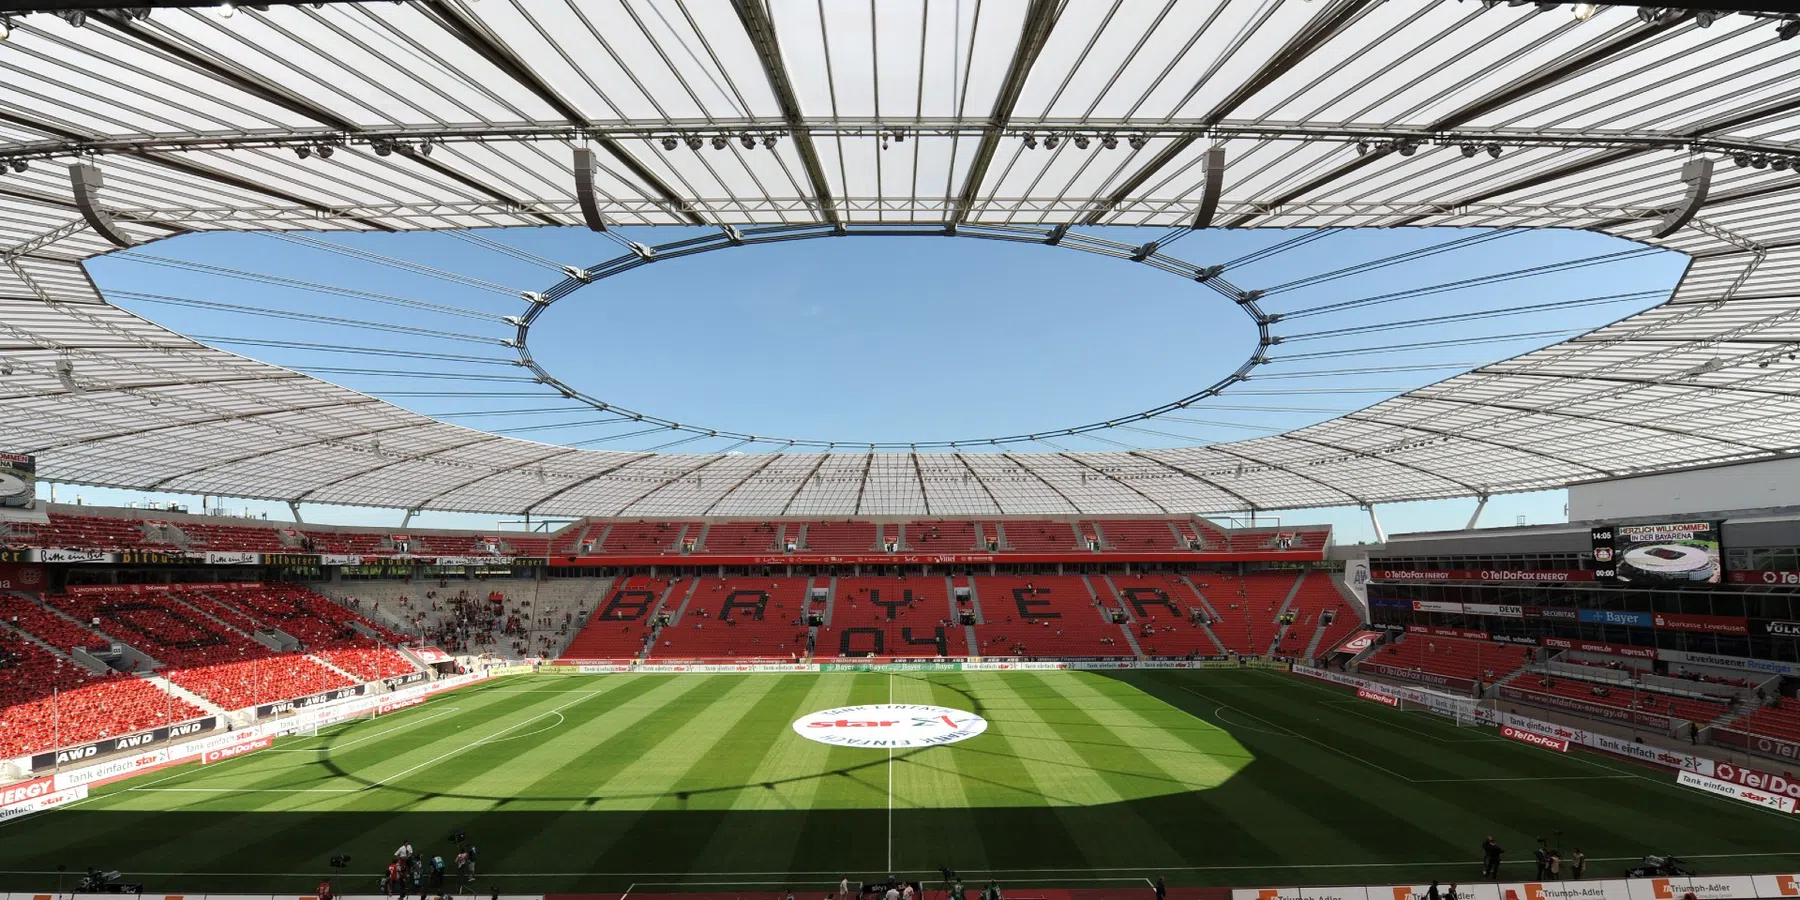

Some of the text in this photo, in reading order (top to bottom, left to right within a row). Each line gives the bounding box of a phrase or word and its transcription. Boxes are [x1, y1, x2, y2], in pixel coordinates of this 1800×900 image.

[1620, 524, 1708, 534] HERZLICH WILLKOMMEN
[1593, 532, 1612, 540] 14:05
[1655, 533, 1692, 541] BAYARENA
[1490, 571, 1568, 580] TelDaFax ENERGY
[1499, 606, 1521, 614] DEVK
[1542, 610, 1575, 619] SECURITAS
[1606, 611, 1639, 624] Bayer
[1667, 620, 1746, 632] Sparkasse Leverkusen
[839, 626, 947, 656] 04
[1581, 643, 1612, 653] express.de
[1620, 647, 1655, 657] express.TV
[1685, 653, 1791, 674] Leverkusener Anzeiger
[407, 674, 422, 683] AWD
[305, 696, 327, 706] AWD
[391, 696, 423, 710] TelDaFax
[1364, 691, 1393, 705] TelDaFax
[270, 702, 294, 715] AWD
[170, 722, 202, 737] AWD
[806, 719, 900, 728] star
[1509, 716, 1525, 727] Tank
[1526, 719, 1553, 733] einfach
[1553, 724, 1573, 738] star
[117, 734, 153, 750] AWD
[236, 731, 252, 741] star
[1513, 731, 1561, 750] TelDaFax
[57, 746, 98, 763] AWD
[220, 739, 269, 758] TelDaFax
[1598, 738, 1684, 766] Tank einfach star
[68, 755, 157, 785] Tank einfach star
[1682, 775, 1768, 803] Tank einfach star
[40, 795, 64, 806] star
[1543, 886, 1604, 898] Triumph-Adler
[1670, 884, 1730, 894] Triumph-Adler
